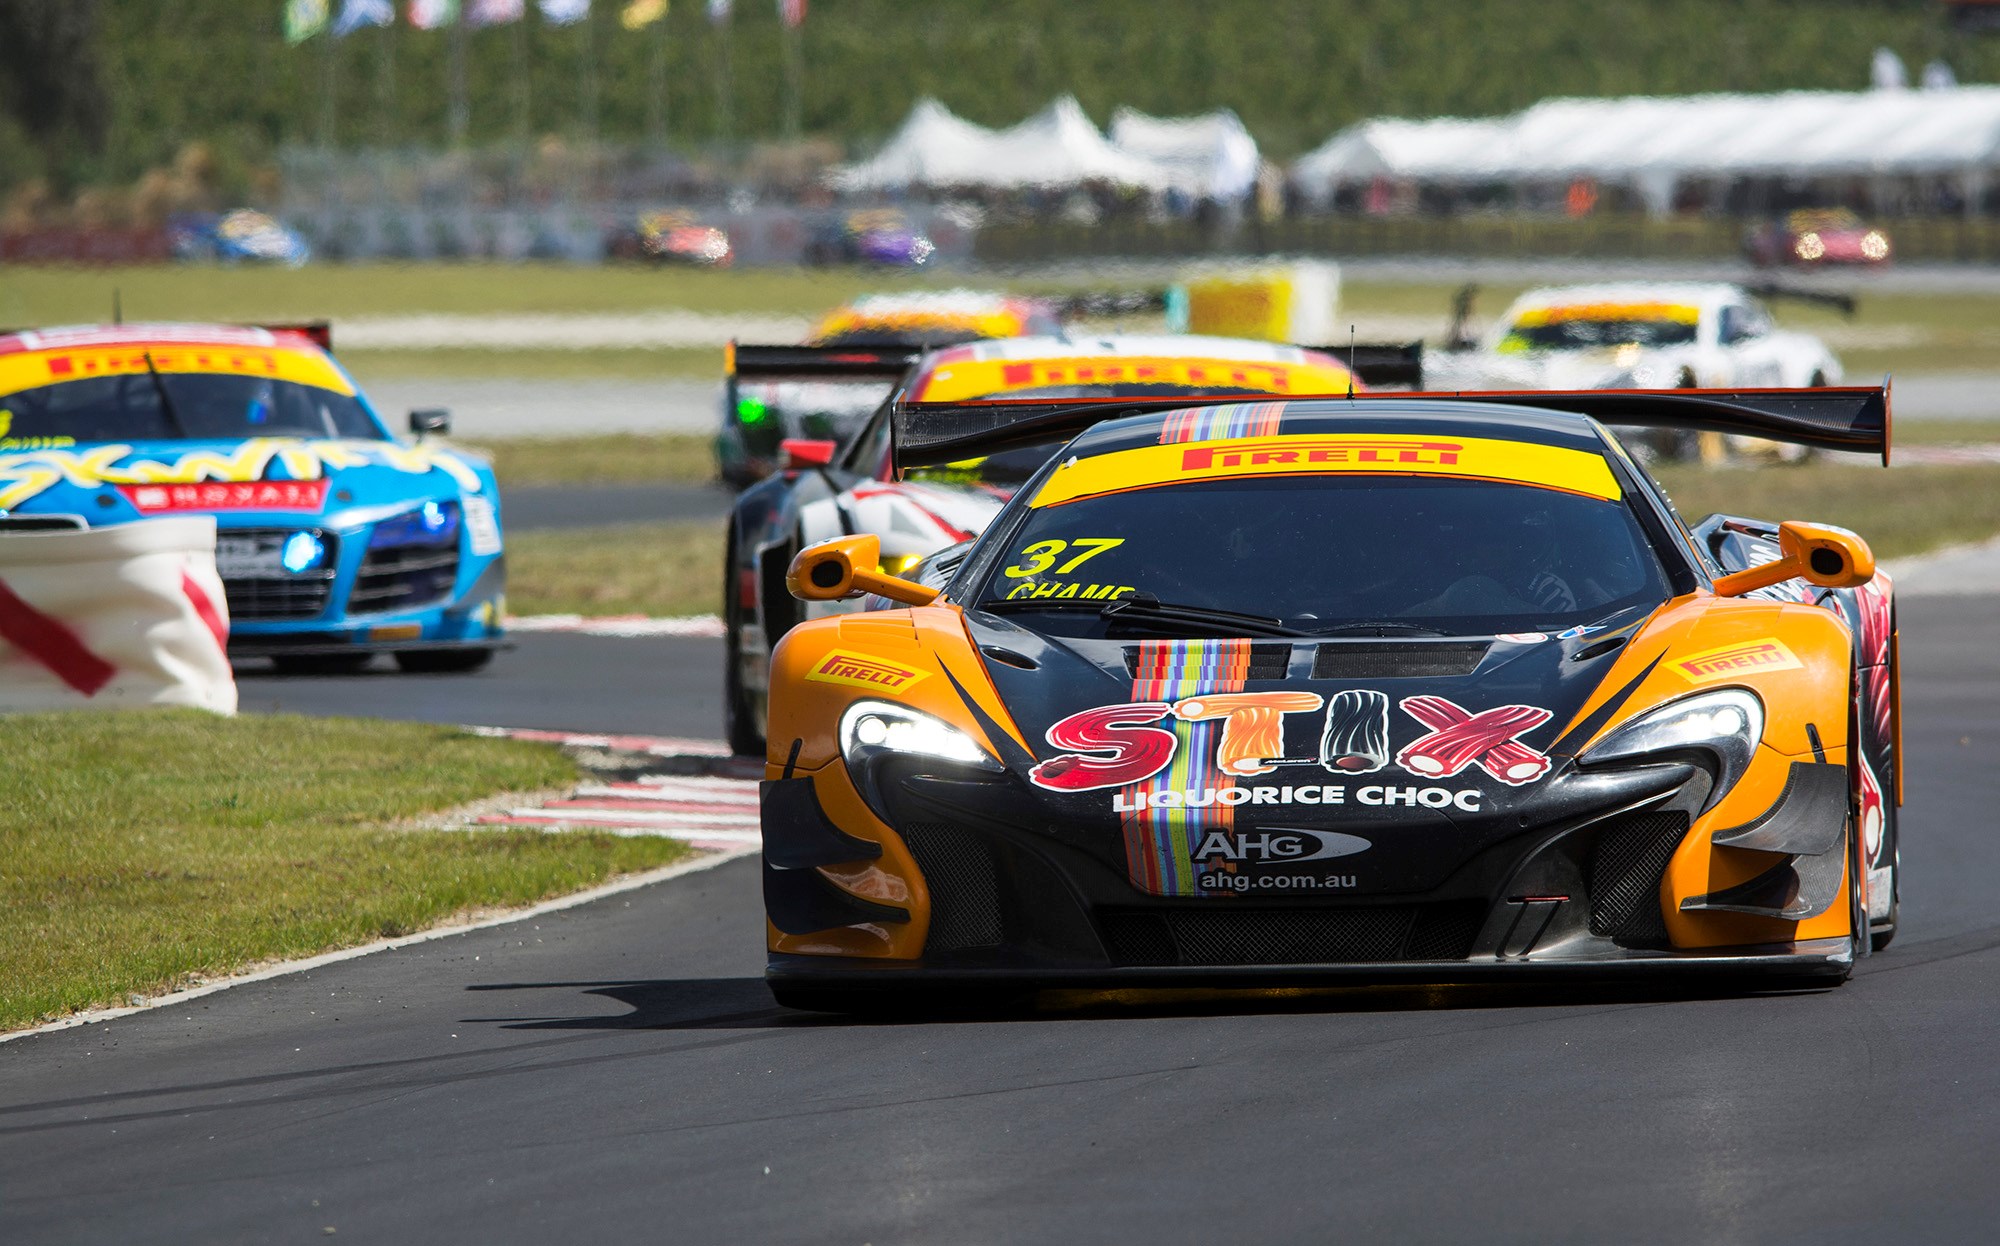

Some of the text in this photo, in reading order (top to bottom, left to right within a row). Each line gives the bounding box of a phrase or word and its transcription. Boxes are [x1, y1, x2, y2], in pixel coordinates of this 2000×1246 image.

[1181, 441, 1464, 471] PIRELLI
[1004, 538, 1126, 578] 37
[818, 655, 916, 687] PIRELLI
[1678, 644, 1787, 677] PIRELLI
[1029, 690, 1554, 793] STIX
[1113, 786, 1481, 813] LIQUORICE CHOC
[1194, 831, 1303, 860] AHG
[1201, 872, 1357, 892] ahg.com.au
